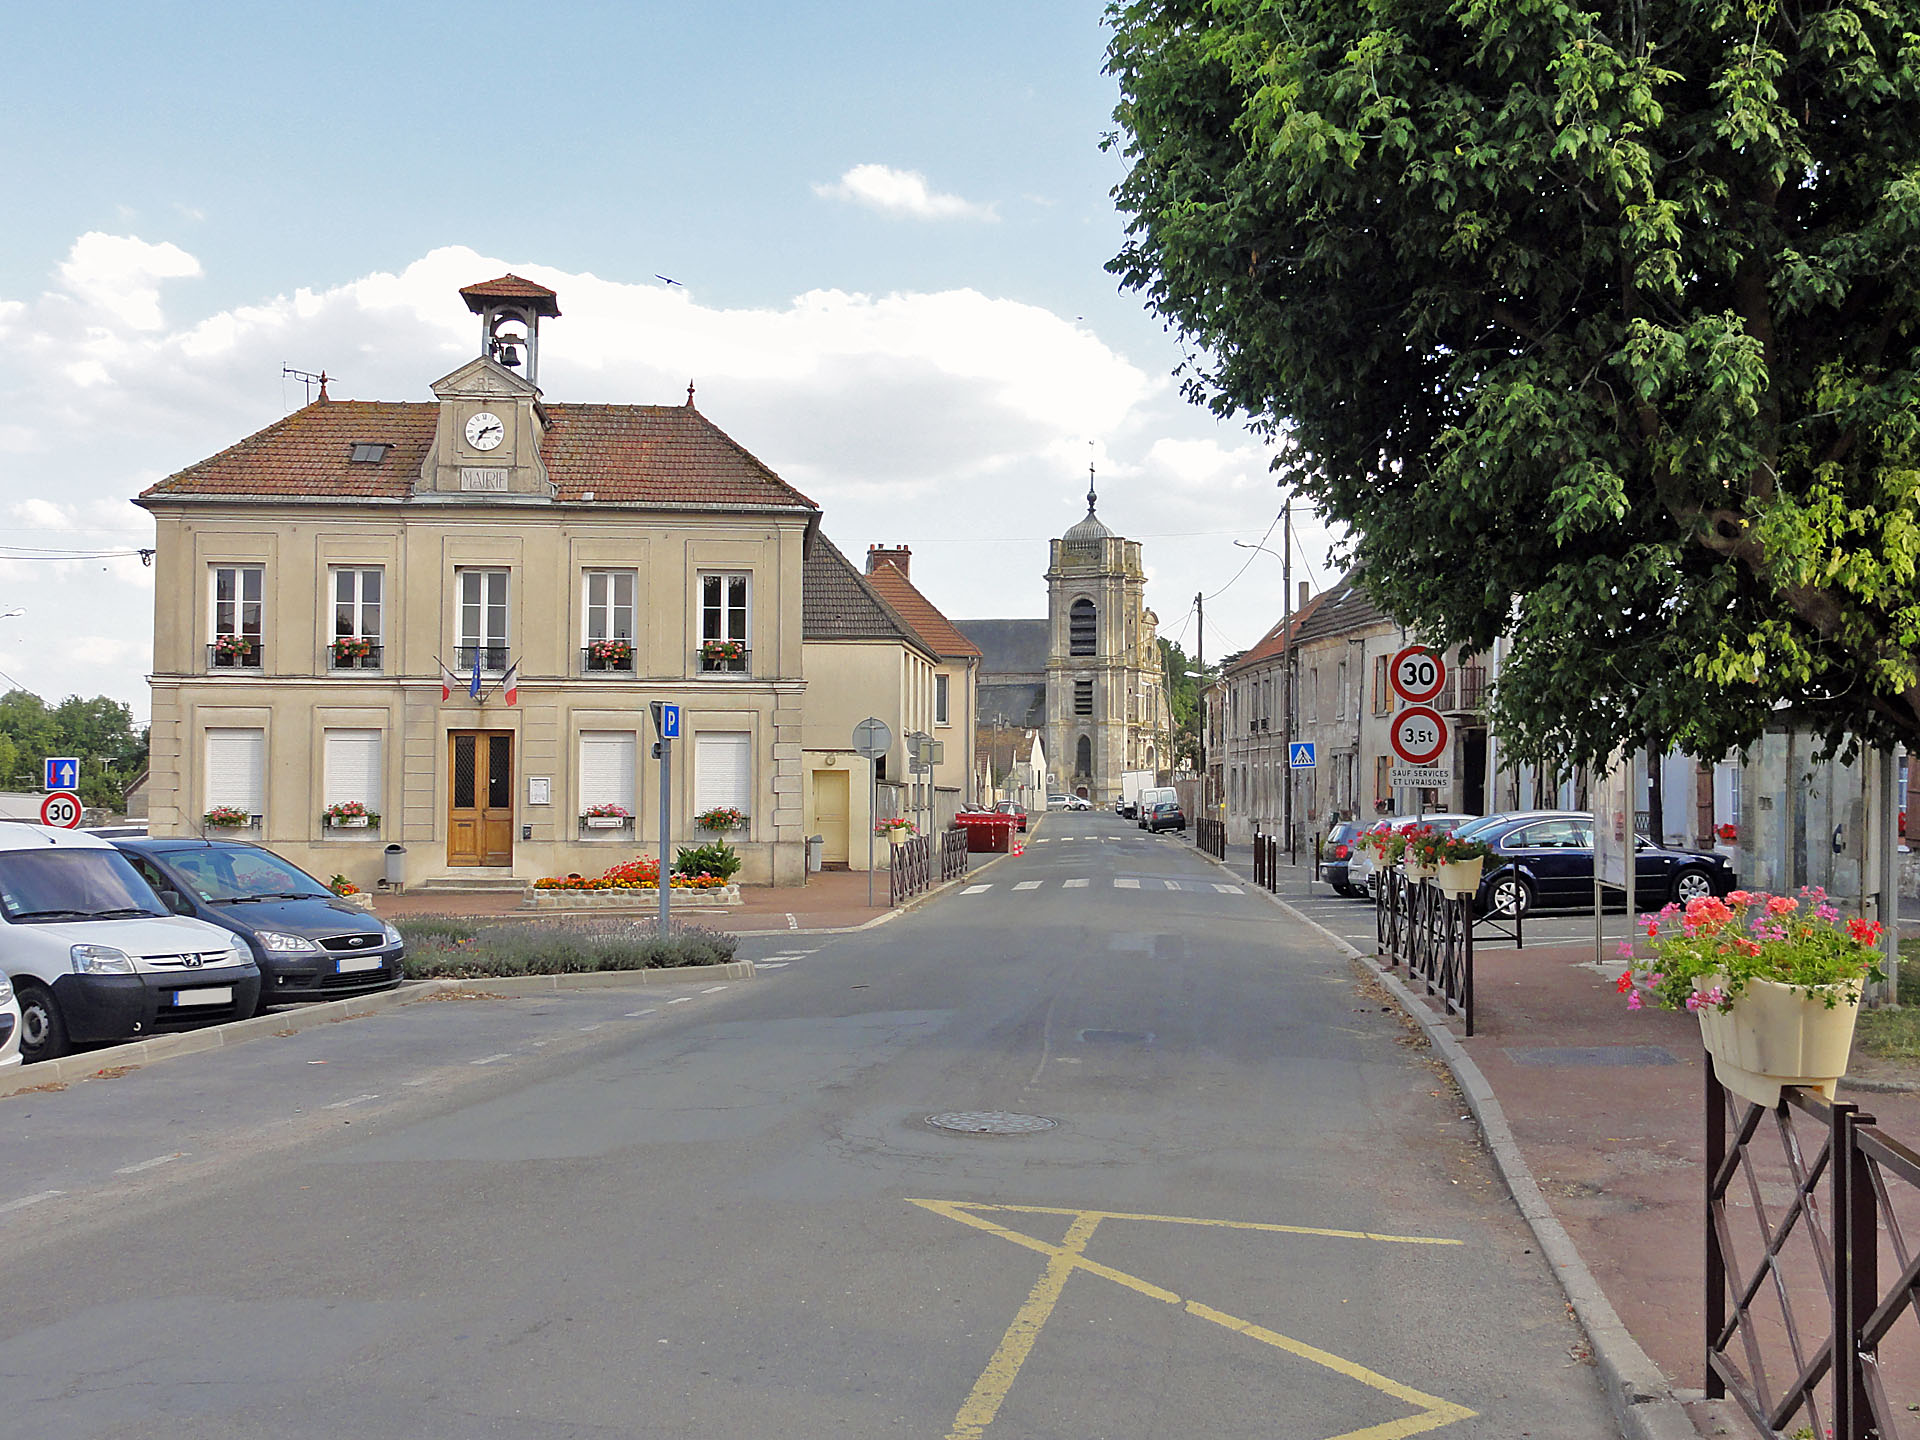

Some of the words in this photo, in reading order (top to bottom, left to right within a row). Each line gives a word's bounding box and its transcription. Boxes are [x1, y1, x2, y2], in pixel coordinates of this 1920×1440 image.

[463, 471, 507, 490] MAIRIE
[1402, 662, 1435, 686] 30
[667, 710, 676, 732] P
[1392, 769, 1411, 777] SAUF
[1413, 769, 1449, 778] SERVICES
[1393, 778, 1402, 786] ET
[1404, 778, 1447, 786] LIVRAISONS
[49, 804, 73, 821] 30
